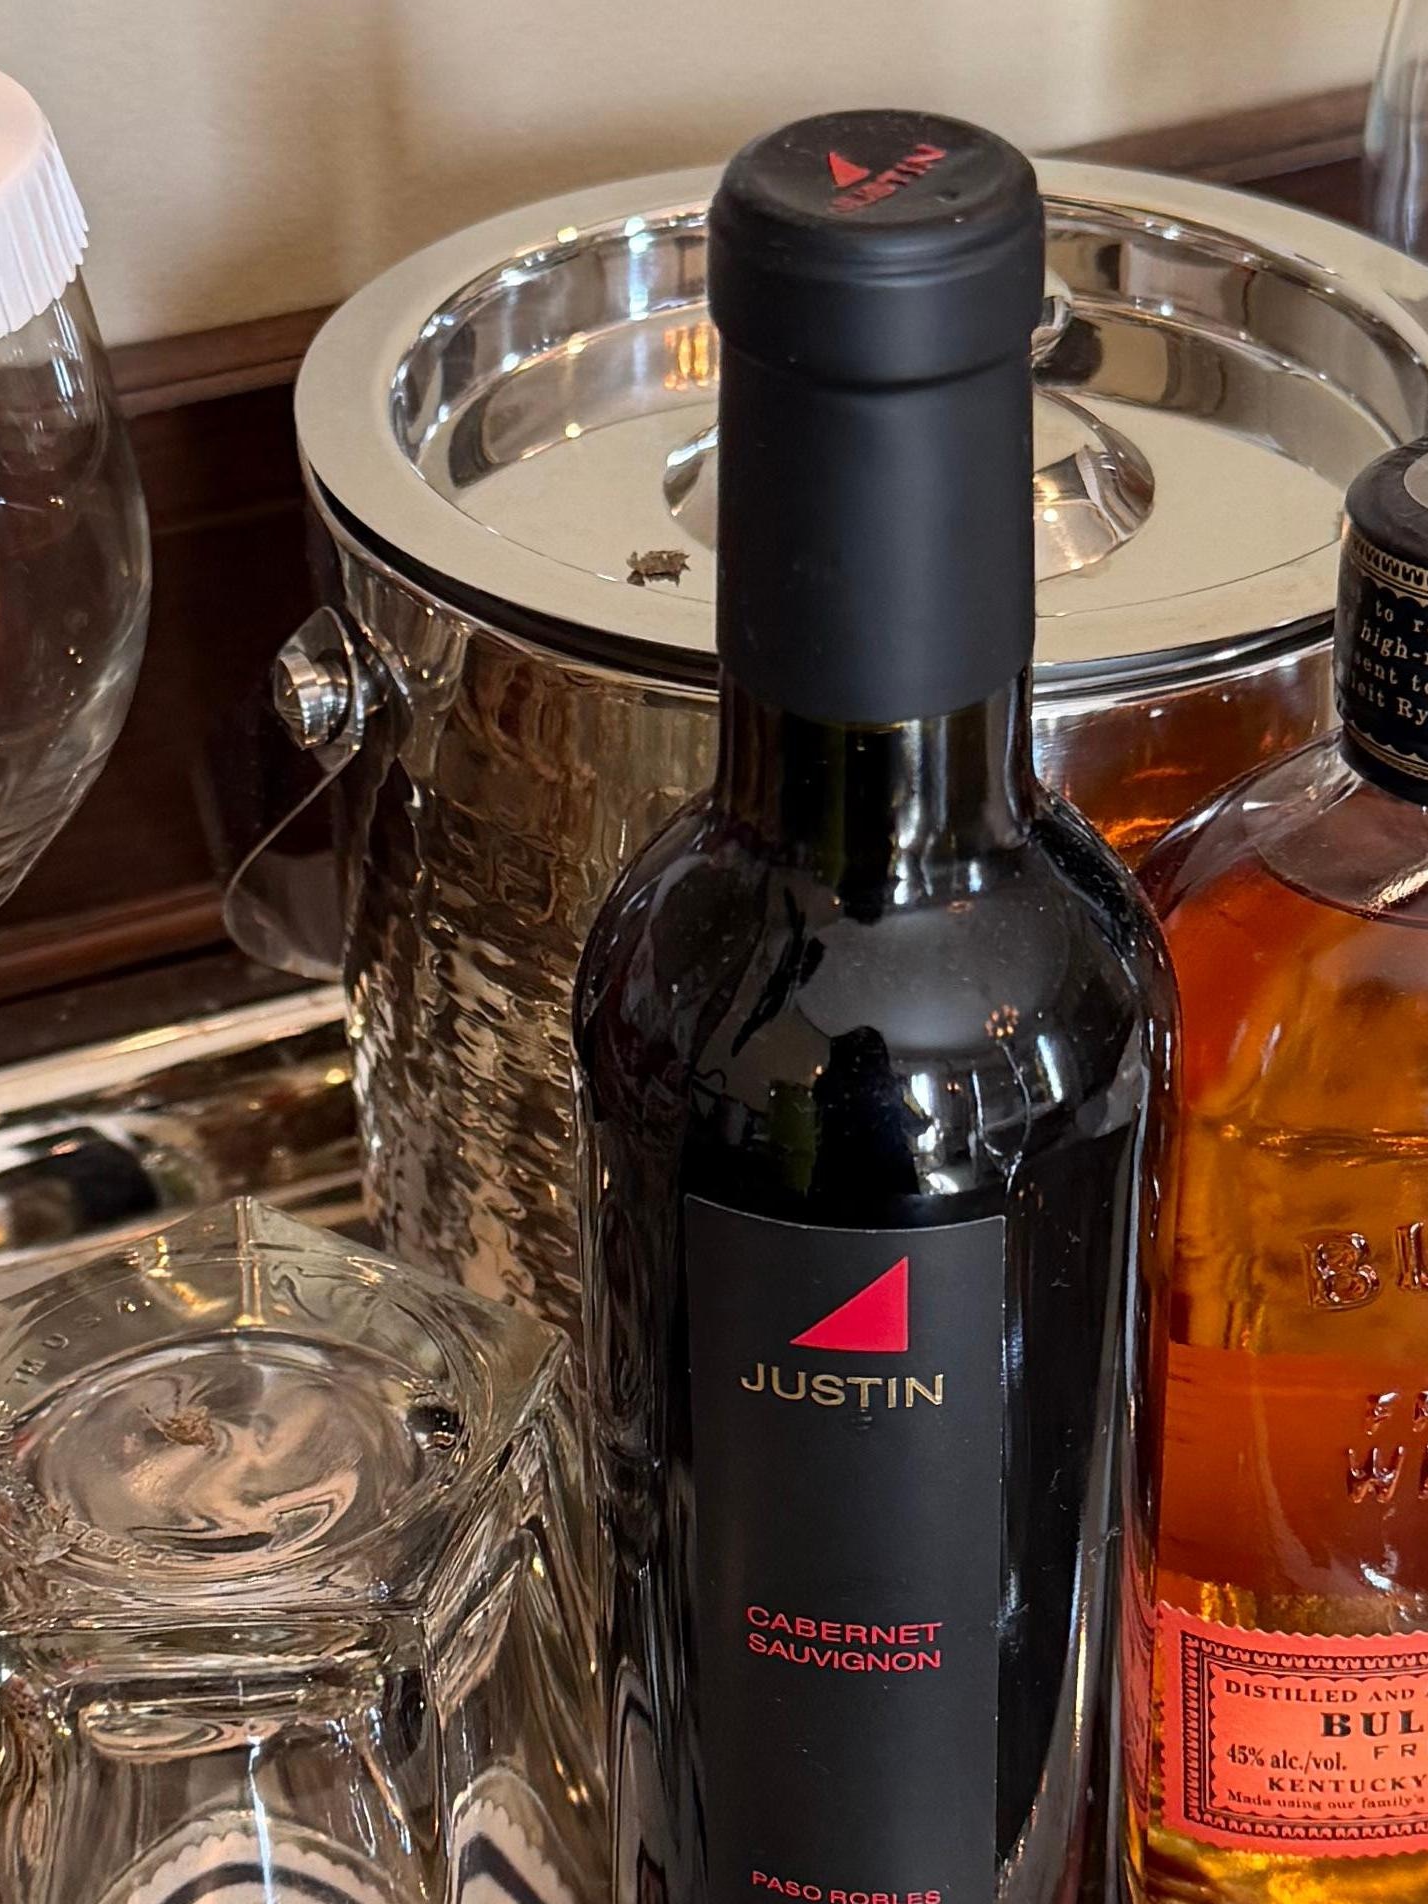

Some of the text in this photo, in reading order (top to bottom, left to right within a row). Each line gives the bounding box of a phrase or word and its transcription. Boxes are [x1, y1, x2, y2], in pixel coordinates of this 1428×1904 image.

[1374, 599, 1394, 623] to
[740, 1362, 945, 1409] JUSTIN
[746, 1605, 943, 1646] CABERNET
[748, 1633, 941, 1673] SAUVIGNON
[1225, 1679, 1358, 1703] DISTILLED
[1369, 1688, 1415, 1702] AND
[1226, 1743, 1348, 1775] 45% alc./vol.
[1227, 1789, 1272, 1807] Made
[1277, 1798, 1322, 1811] using
[1327, 1800, 1355, 1810] our
[1361, 1794, 1425, 1810] family's
[1268, 1775, 1428, 1795] KENTUCKY
[752, 1870, 823, 1902] PASO
